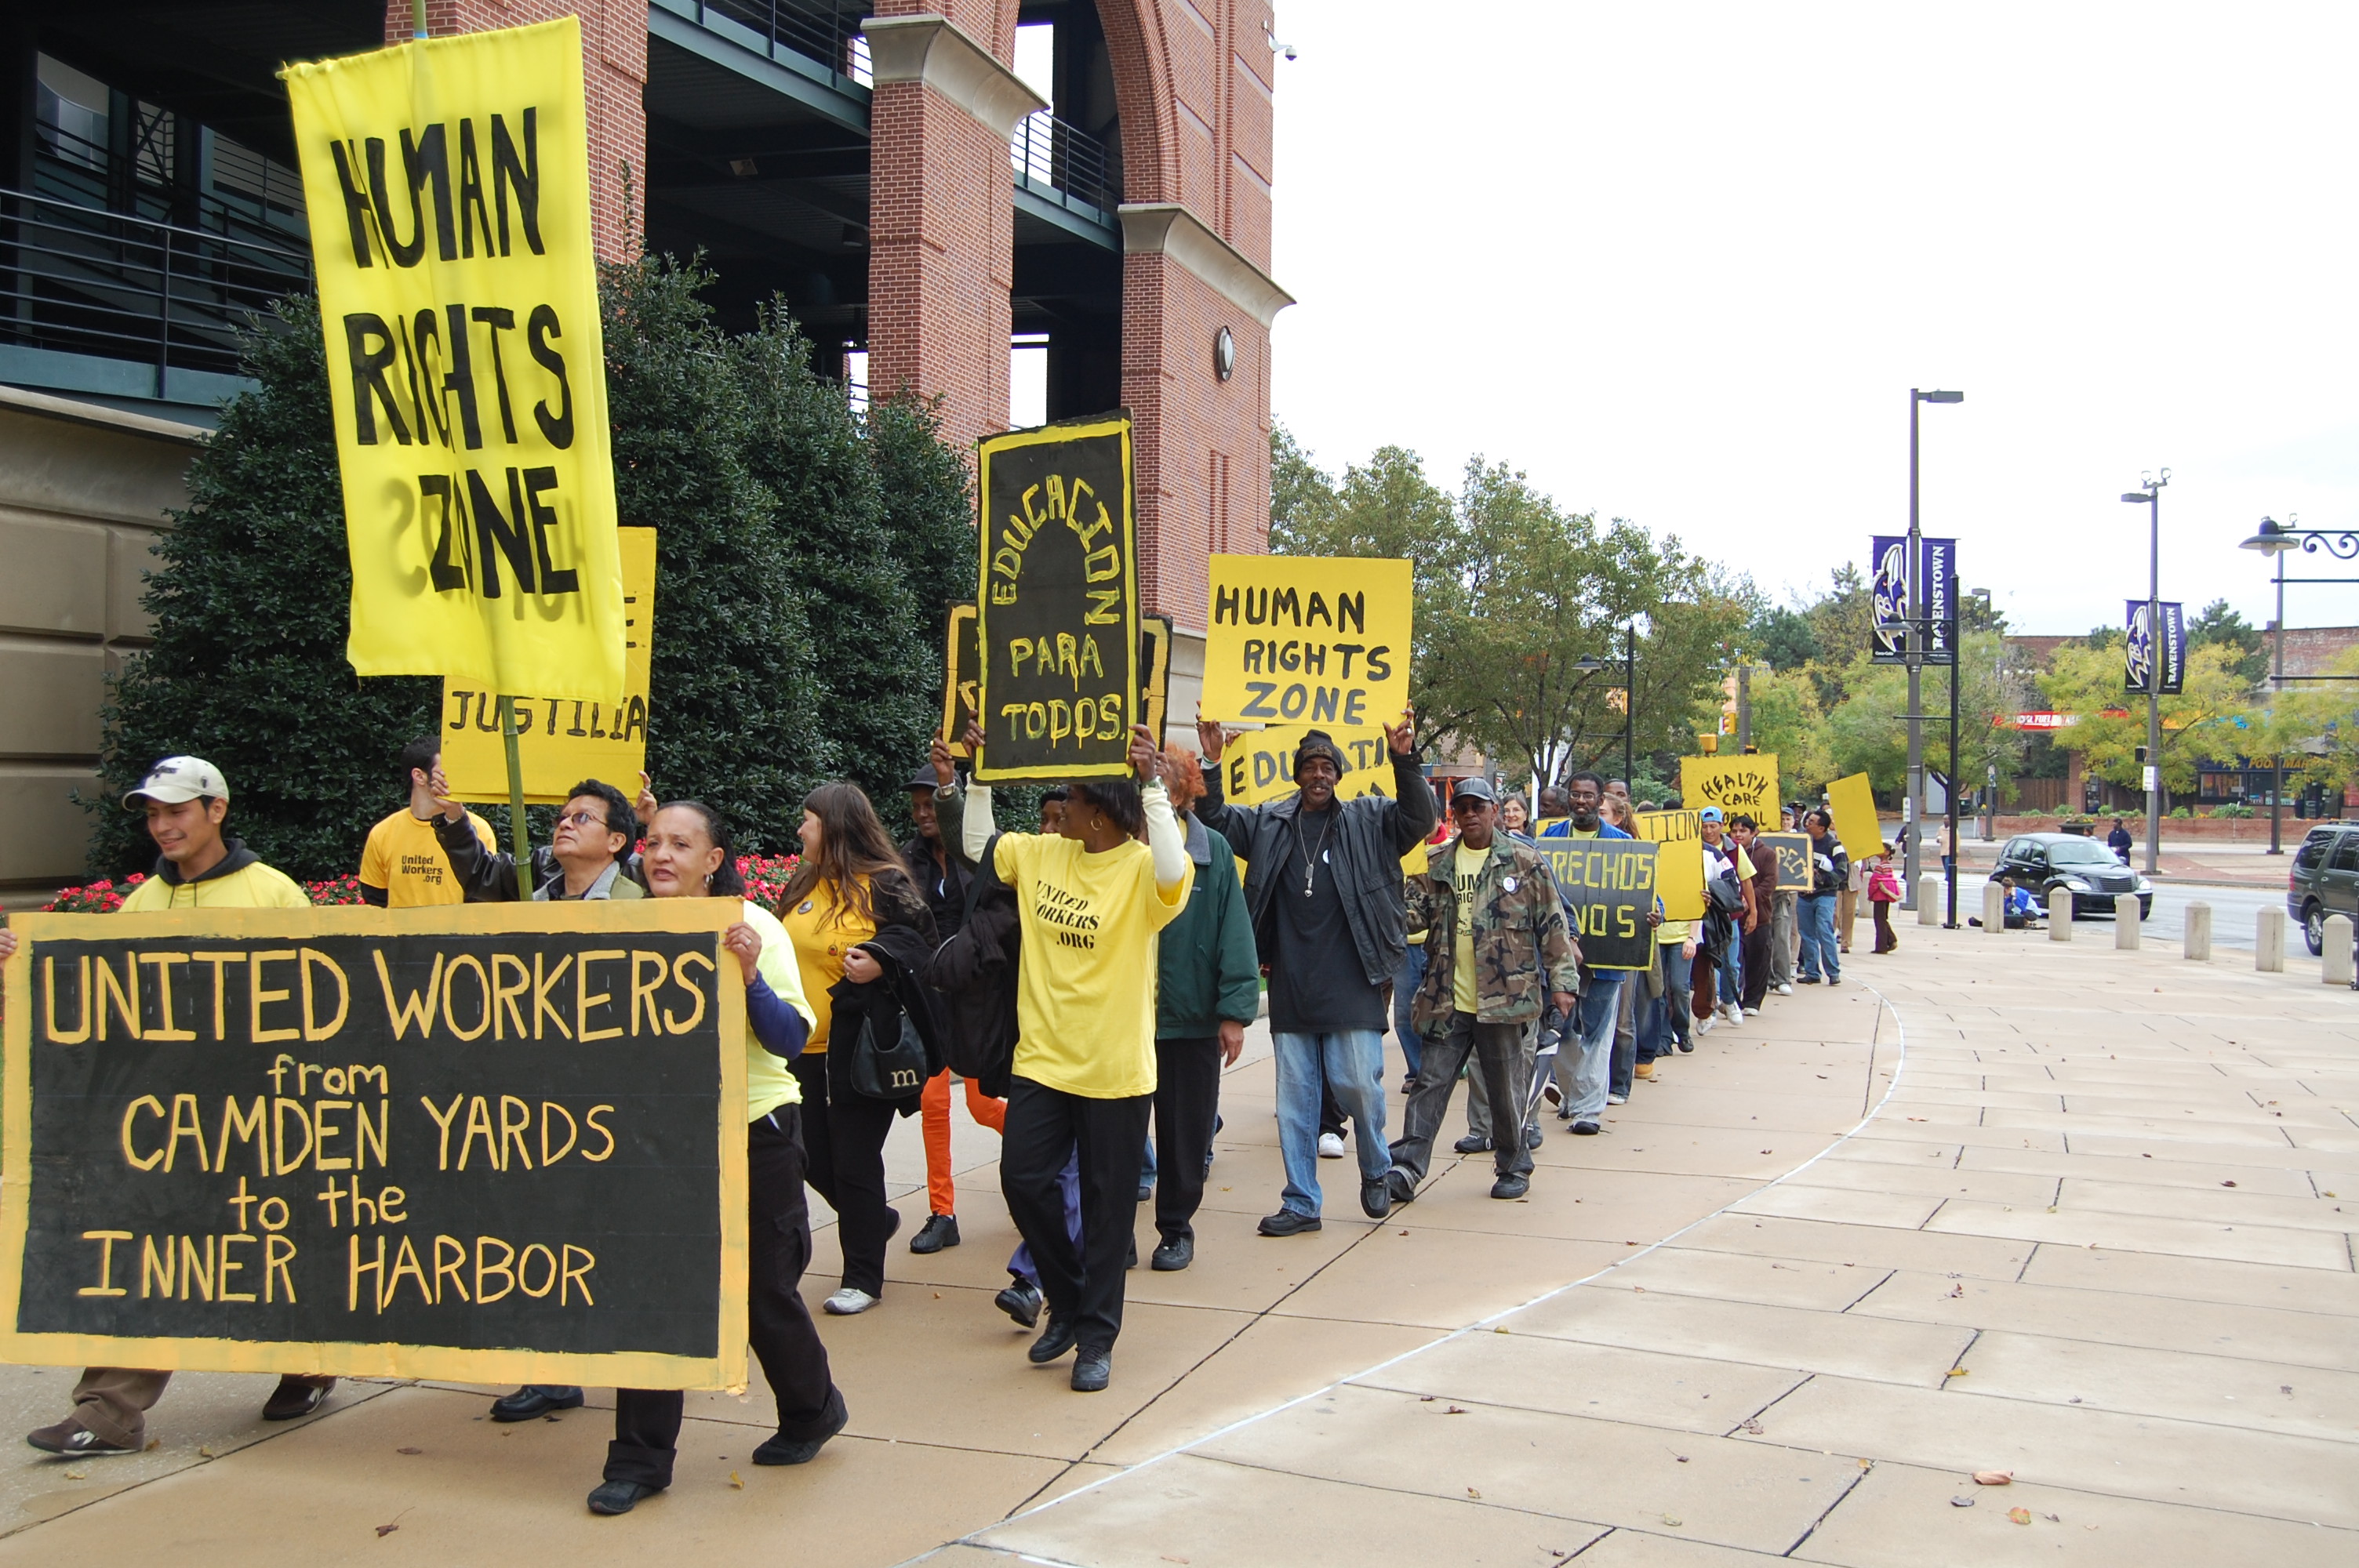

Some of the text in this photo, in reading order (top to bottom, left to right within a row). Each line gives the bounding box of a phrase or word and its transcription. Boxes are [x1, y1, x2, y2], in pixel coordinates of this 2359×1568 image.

[330, 107, 545, 269] HUMAN
[343, 303, 574, 454] RIGHTS
[420, 466, 580, 599] ZONE
[1215, 584, 1365, 633] HUMAN
[1010, 633, 1103, 692] PARA
[1244, 640, 1391, 681] RIGHTS
[2167, 607, 2178, 684] RAVENSTOWN
[1240, 682, 1366, 725] ZONE
[2248, 758, 2308, 769] FOO MAR
[1702, 771, 1768, 800] HEALTH
[1723, 793, 1761, 806] CARE
[402, 855, 434, 865] United
[402, 865, 443, 875] Workers
[1036, 902, 1100, 931] ORKERS
[1056, 931, 1096, 950] .ORG
[45, 947, 716, 1045] UNITED WORKERS
[267, 1053, 388, 1096] from
[890, 1068, 921, 1088] m
[122, 1093, 616, 1177] CAMDEN YARDS
[229, 1174, 409, 1232] to the
[78, 1230, 595, 1315] INNER HARBOR
